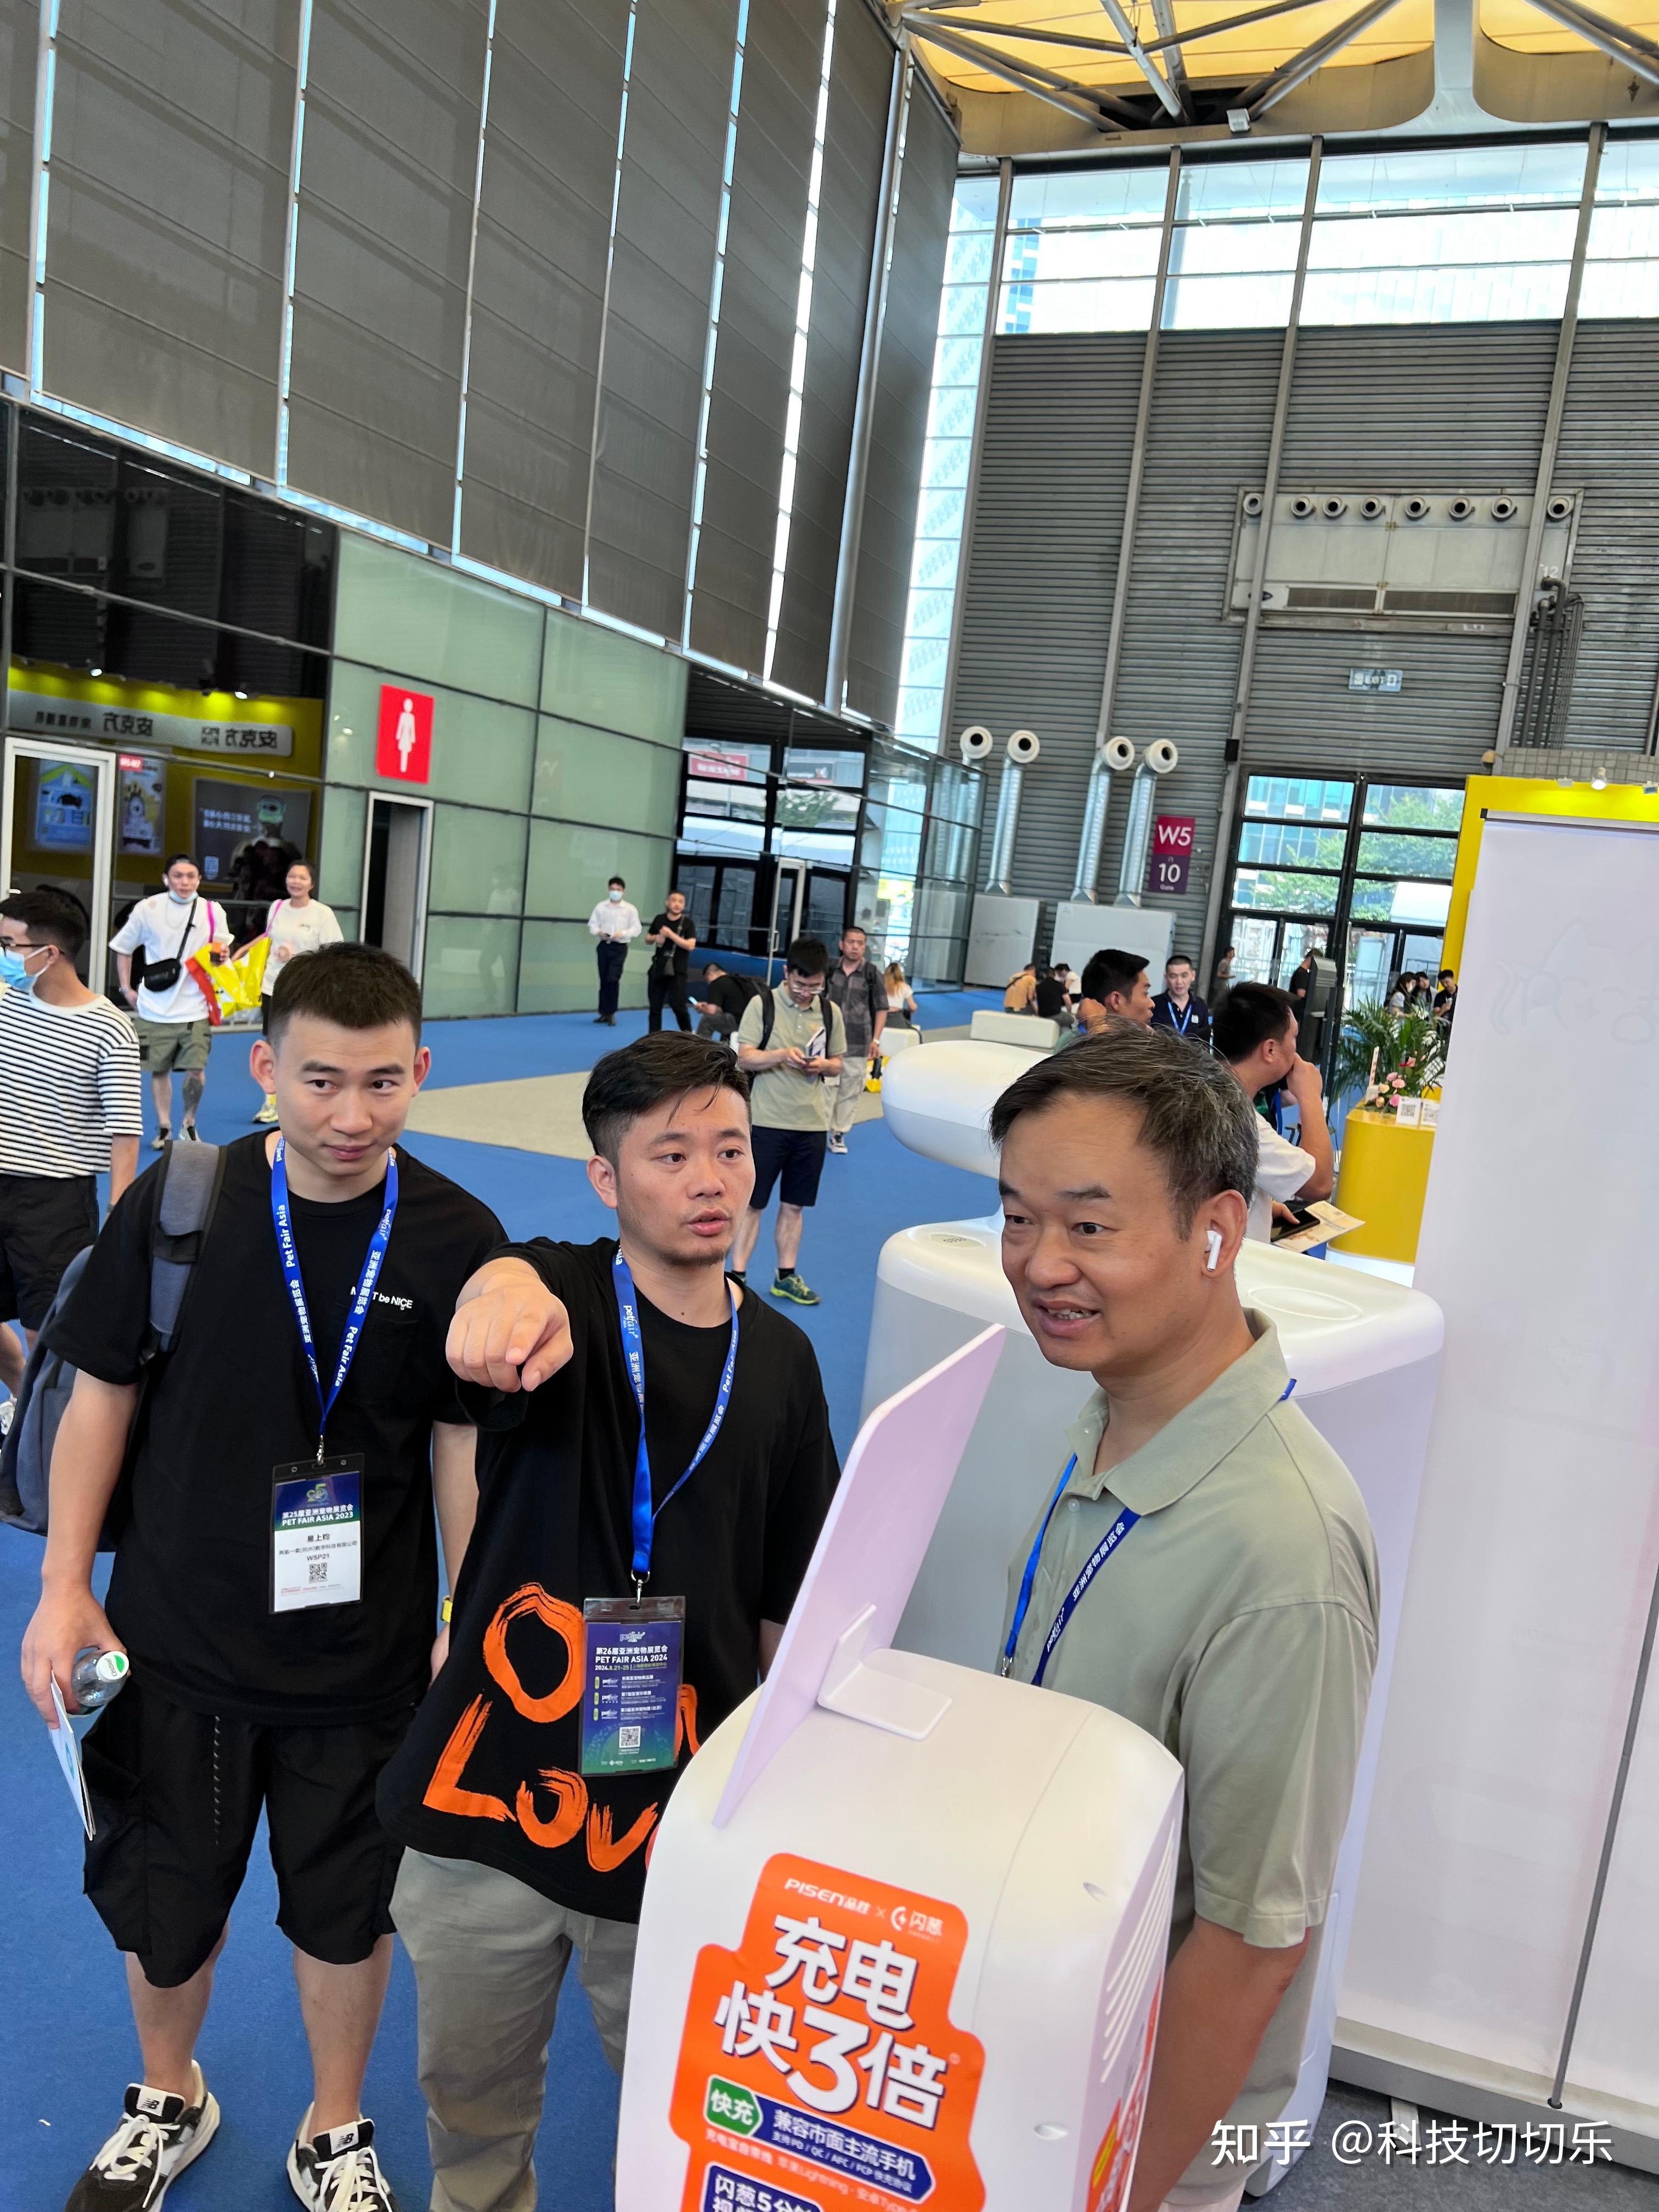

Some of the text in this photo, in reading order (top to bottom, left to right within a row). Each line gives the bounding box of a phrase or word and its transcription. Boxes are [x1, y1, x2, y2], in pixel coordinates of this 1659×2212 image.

[1158, 825, 1192, 847] W5
[1159, 863, 1181, 883] 10
[276, 1204, 296, 1268] Pet Fair Asia
[379, 1293, 391, 1304] be
[335, 1326, 358, 1387] Pet Fair Asia
[281, 1511, 354, 1526] PET FAIR ASIA 2023
[596, 1645, 668, 1655] 第26届亚洲宠物展览会
[650, 1654, 668, 1662] 2024
[765, 1914, 918, 2032] 充电
[714, 1980, 947, 2130] 快3倍
[710, 2088, 755, 2126] 快充
[774, 2108, 917, 2181] 兼容市面主流手机
